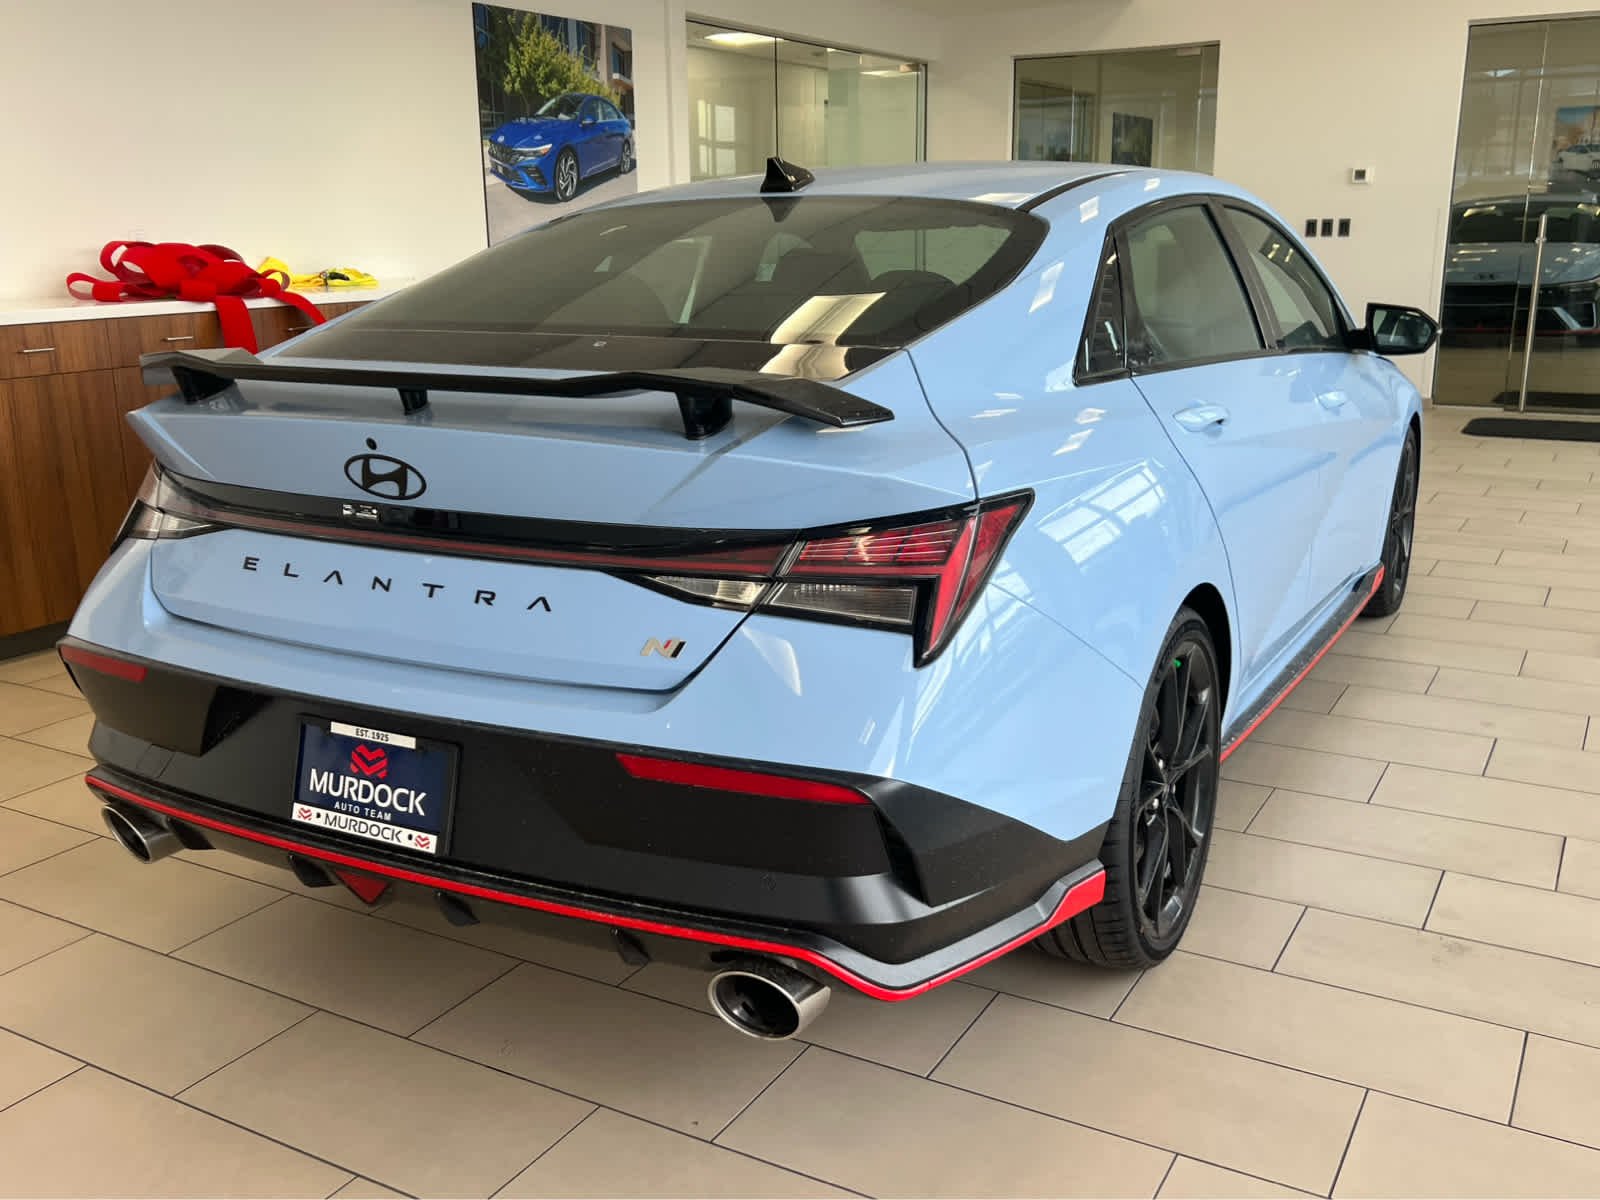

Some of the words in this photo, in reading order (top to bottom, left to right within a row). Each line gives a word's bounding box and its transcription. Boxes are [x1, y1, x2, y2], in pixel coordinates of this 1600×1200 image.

[242, 556, 552, 612] ELANTRA
[355, 727, 371, 738] EST.
[371, 731, 389, 742] 1925
[309, 768, 427, 816] MURDOCK
[334, 801, 360, 814] AUTO
[364, 807, 392, 821] TEAM
[324, 813, 401, 843] MURDOCK
